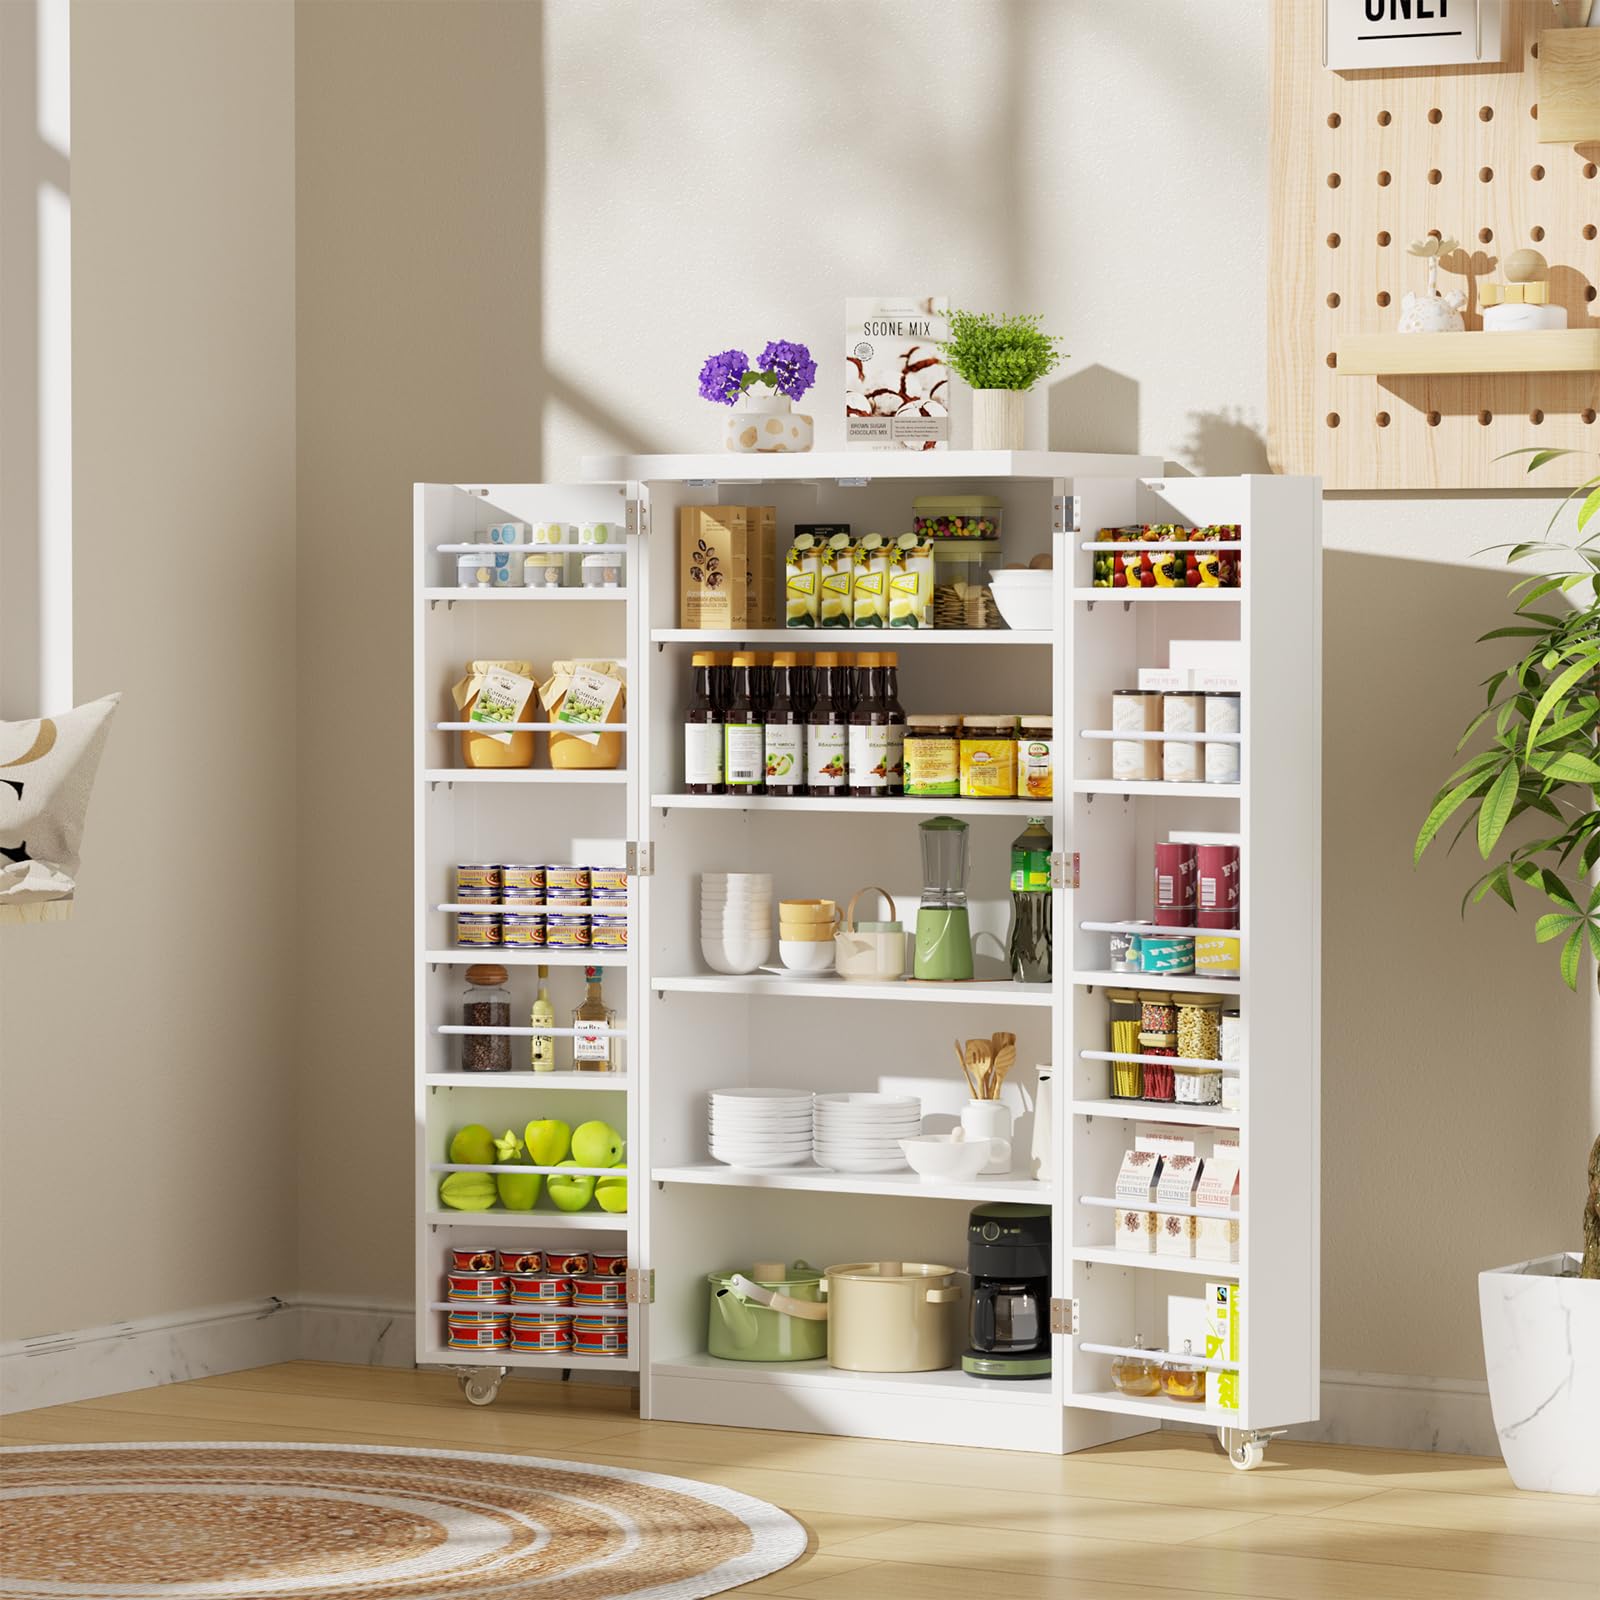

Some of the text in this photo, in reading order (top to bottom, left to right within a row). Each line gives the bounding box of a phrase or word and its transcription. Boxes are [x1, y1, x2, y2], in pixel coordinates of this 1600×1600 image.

[864, 321, 931, 336] SCONE MIX
[1149, 941, 1194, 956] FRES
[1156, 955, 1194, 967] APP
[1195, 953, 1233, 964] ORK
[1197, 1193, 1229, 1203] CHUNKS
